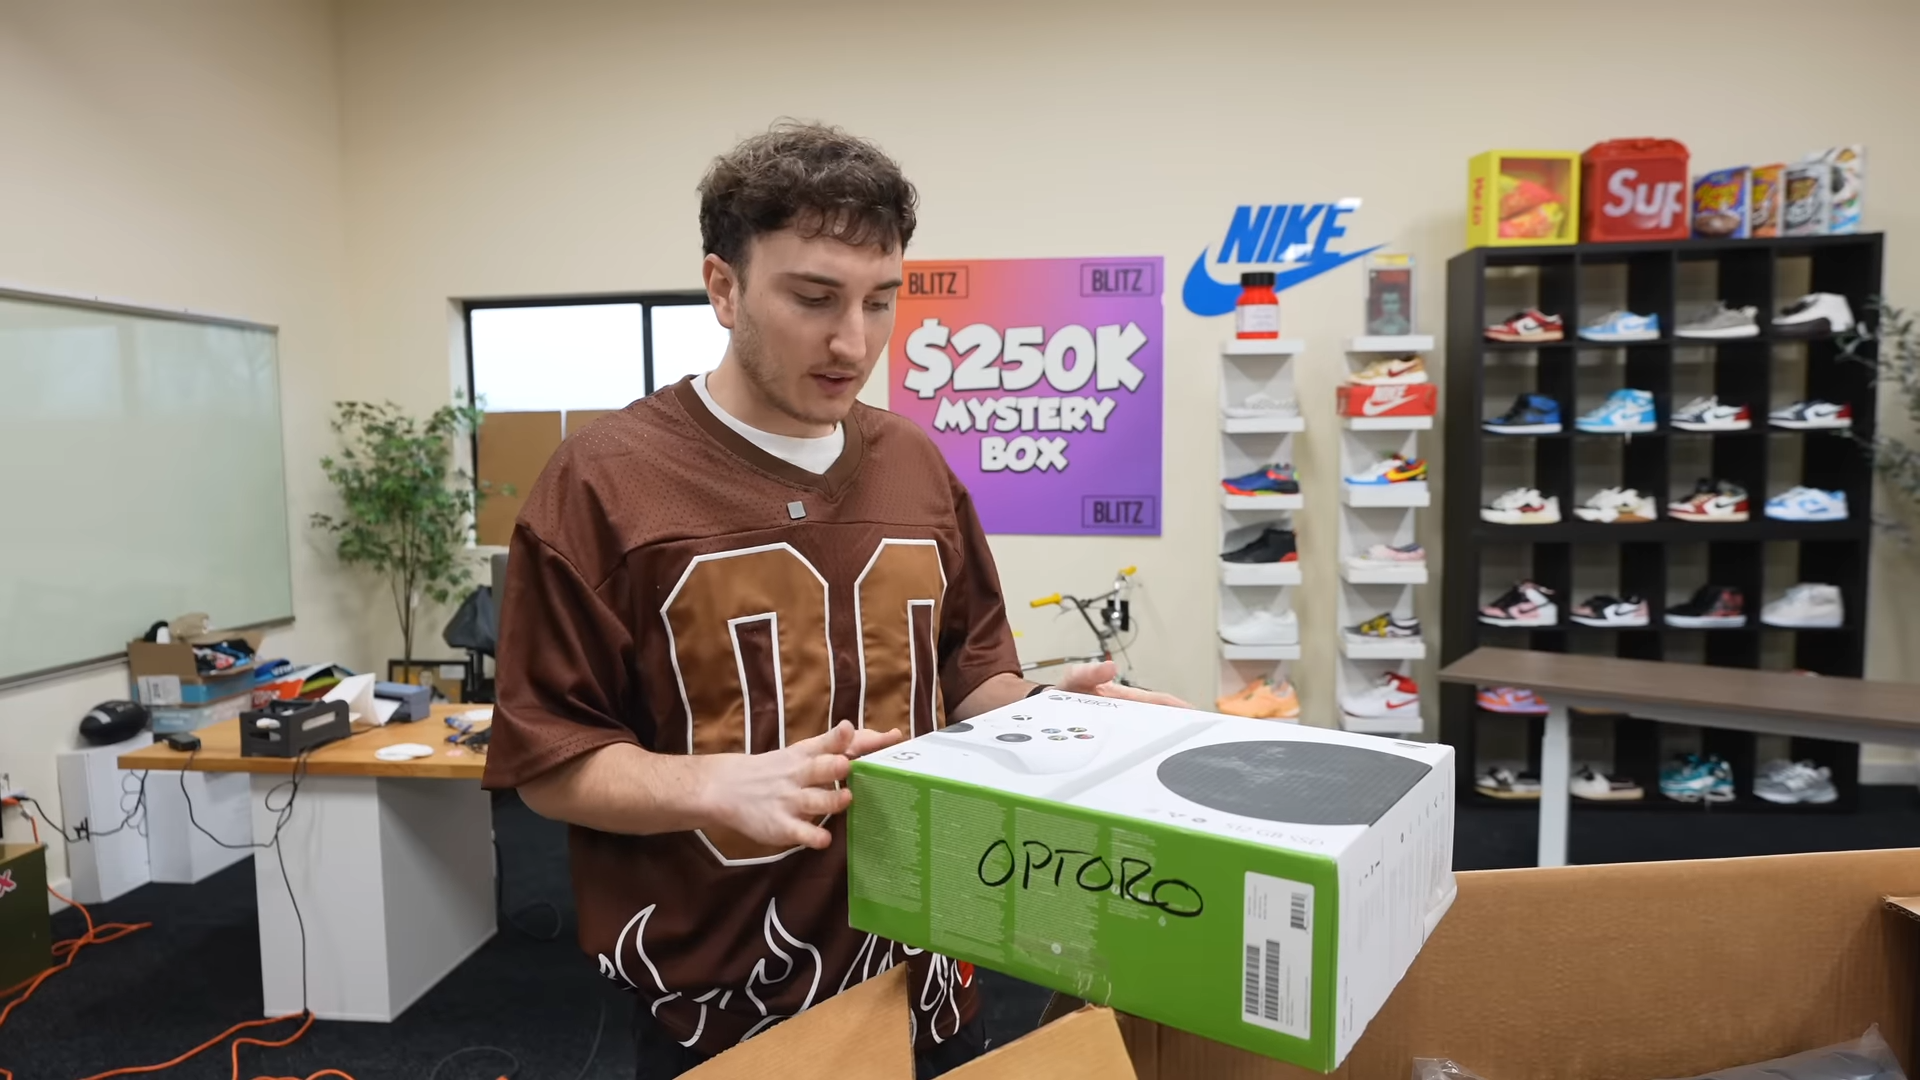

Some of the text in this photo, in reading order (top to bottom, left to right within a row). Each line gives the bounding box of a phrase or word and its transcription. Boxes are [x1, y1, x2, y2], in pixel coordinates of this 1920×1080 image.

[1216, 198, 1362, 263] NIKE
[908, 272, 958, 295] BLITZ
[1091, 268, 1143, 292] BLITZ
[903, 318, 1148, 399] $250K
[933, 395, 1118, 434] MYSTERY
[980, 435, 1069, 473] BOX
[1093, 501, 1144, 524] BLITZ
[1073, 698, 1123, 709] XBOX
[978, 839, 1204, 918] OPTORO
